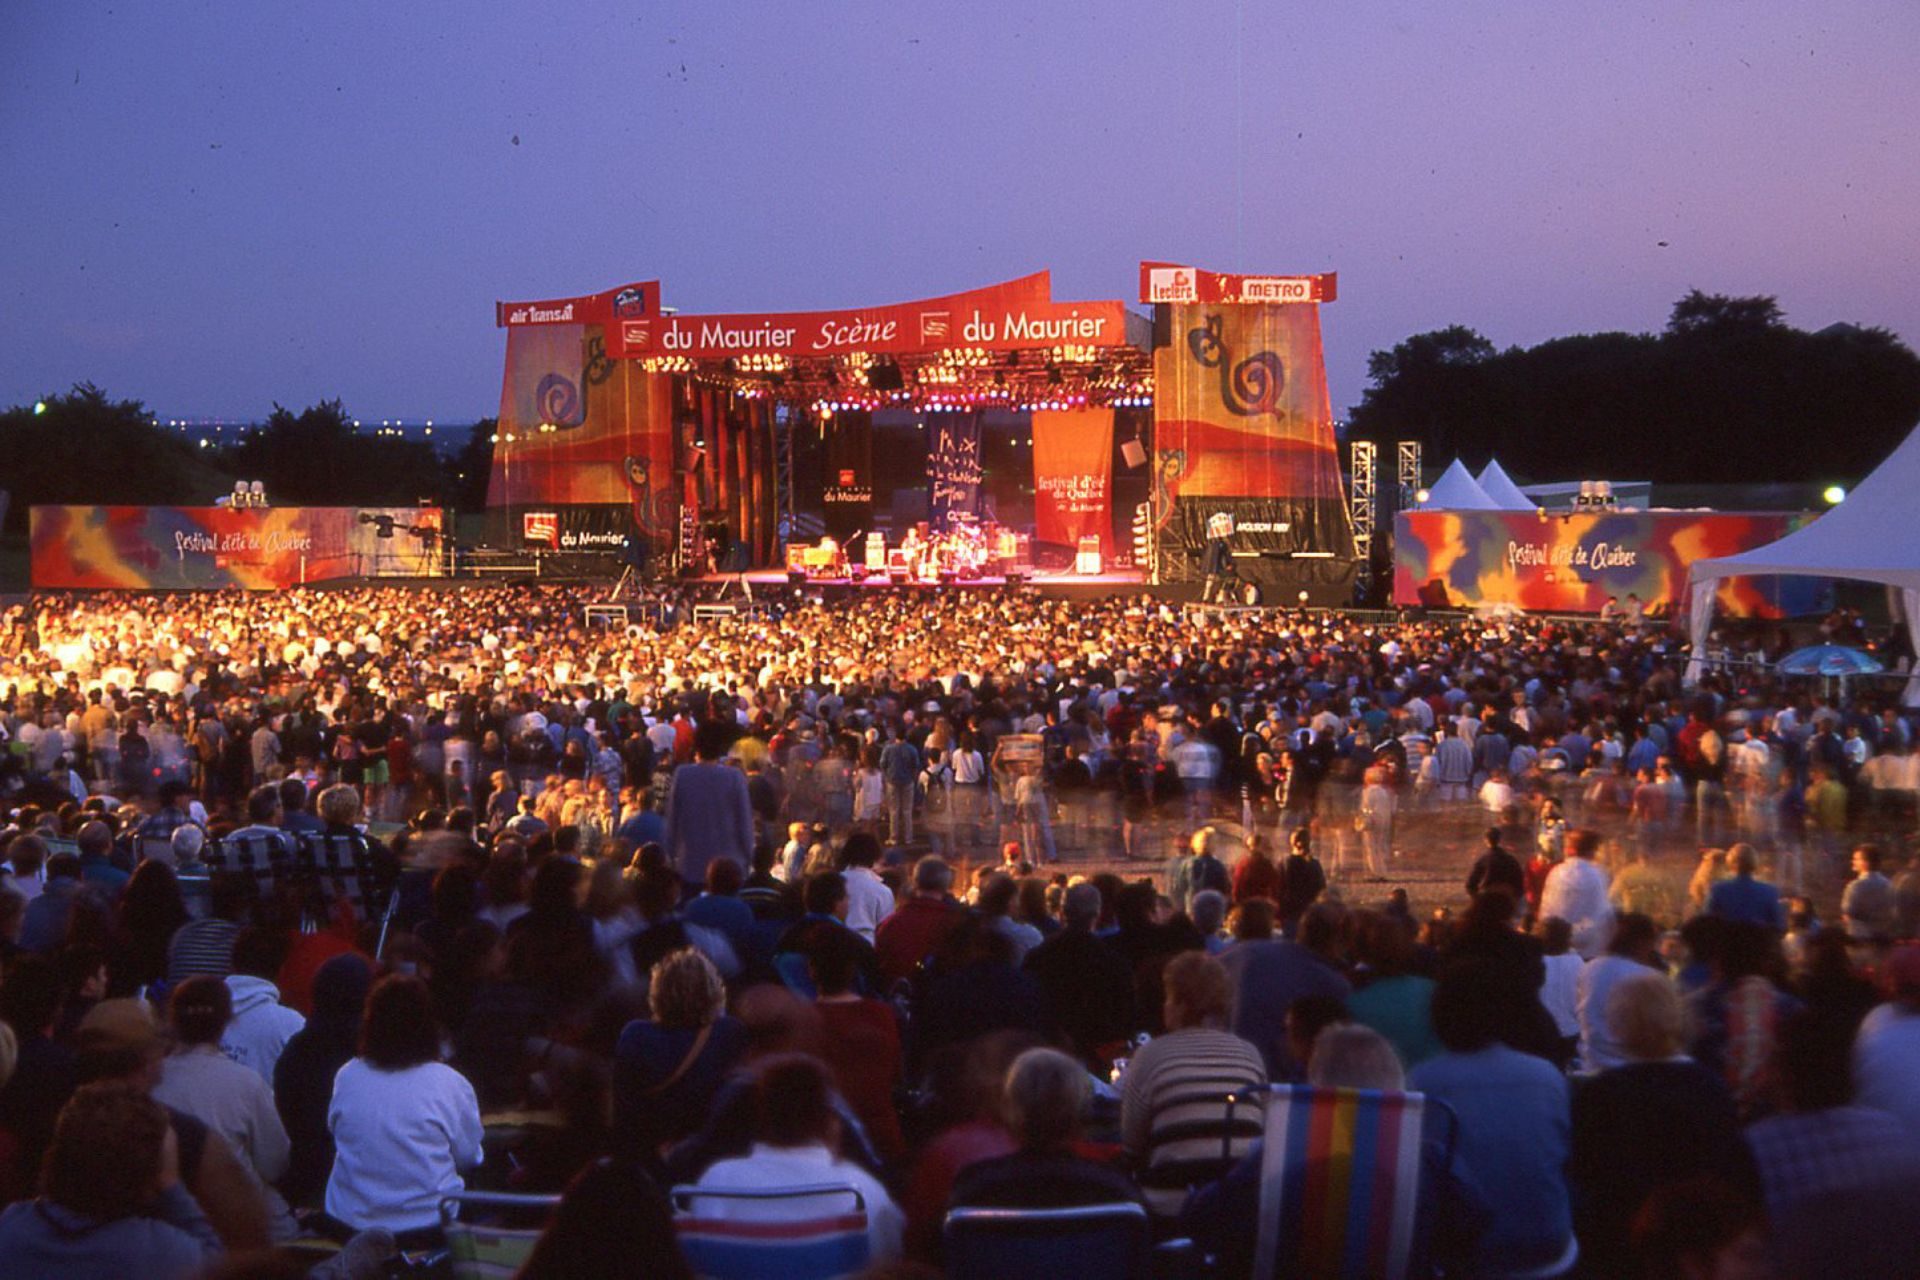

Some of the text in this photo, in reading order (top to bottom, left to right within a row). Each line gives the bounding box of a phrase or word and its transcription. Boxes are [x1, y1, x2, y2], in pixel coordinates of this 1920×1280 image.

[1250, 284, 1304, 297] METRO
[510, 309, 527, 323] air
[963, 310, 1105, 342] du Maurier
[663, 318, 896, 349] du Maurier Scène
[824, 491, 871, 502] du Maurier
[175, 530, 217, 560] festival
[561, 530, 625, 546] du Maurier
[1508, 540, 1547, 574] festival
[1575, 545, 1588, 565] de
[1590, 542, 1636, 570] Québec
